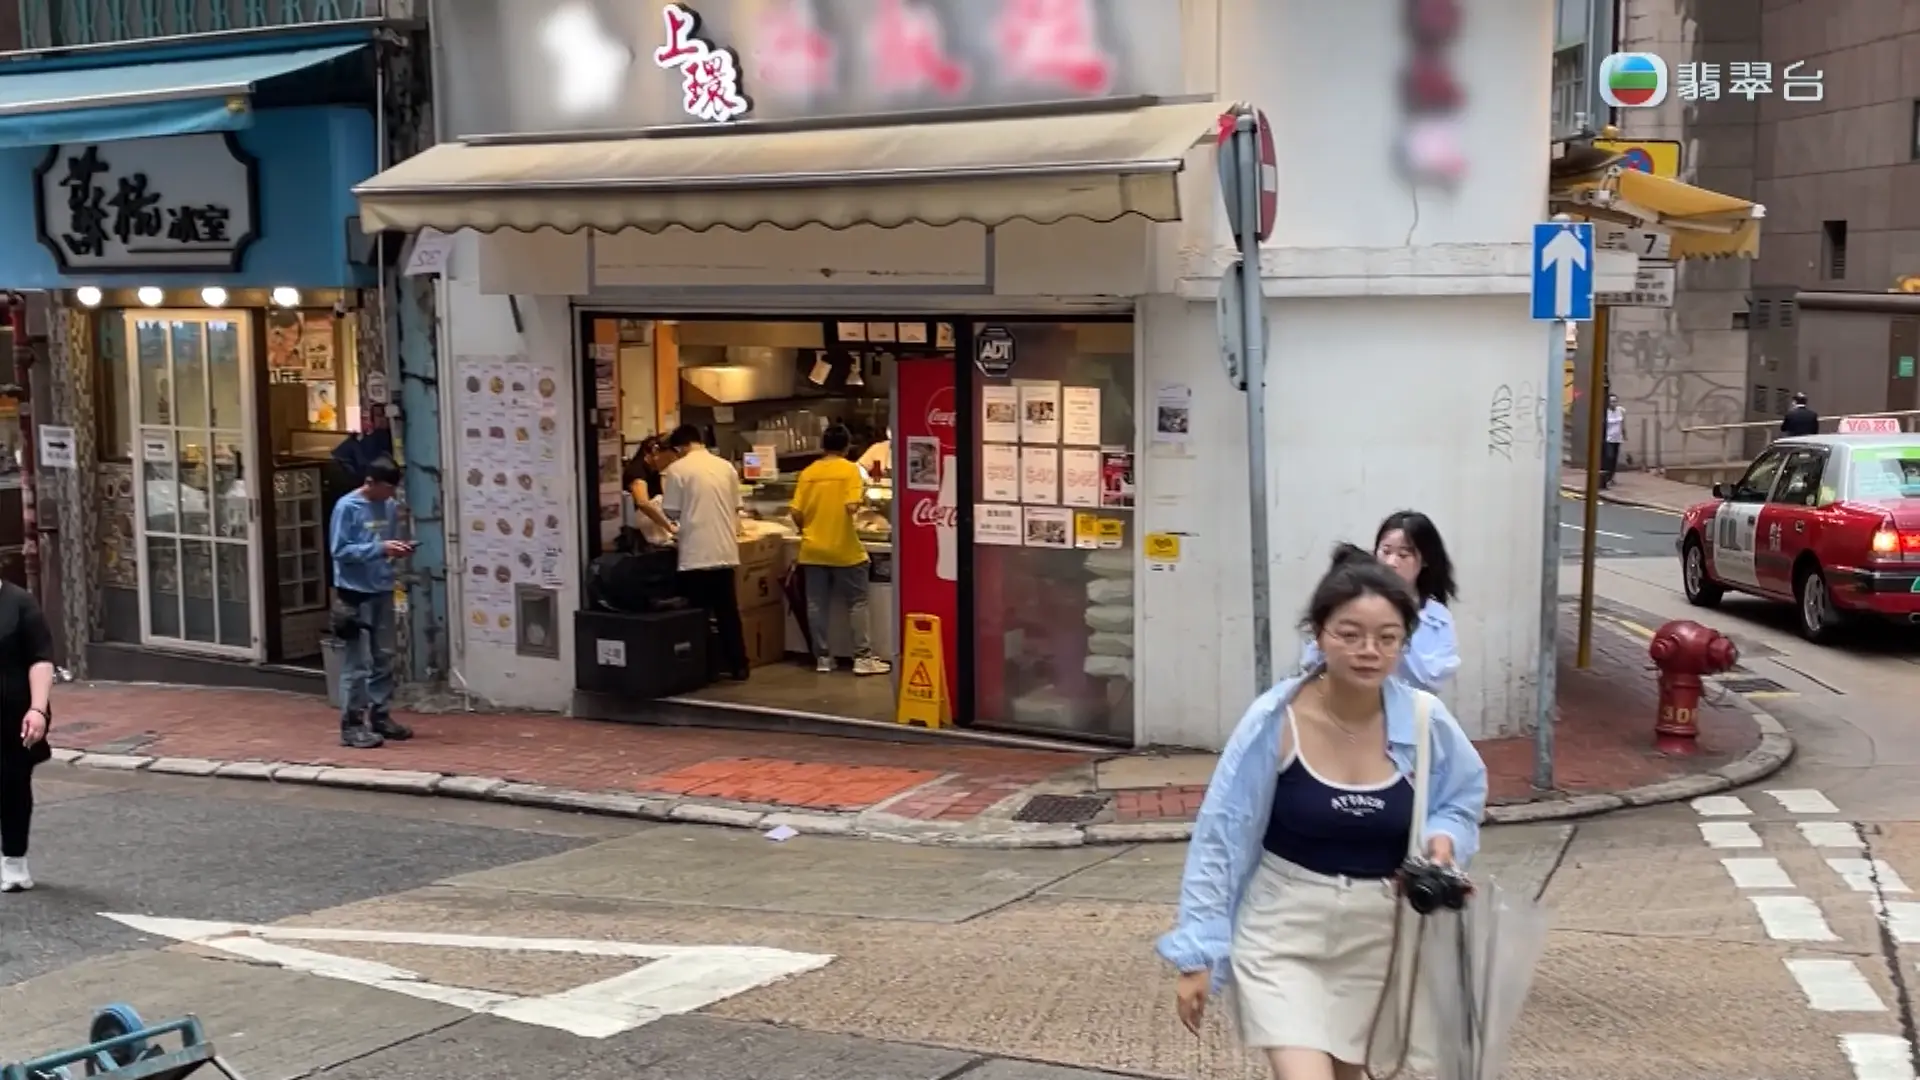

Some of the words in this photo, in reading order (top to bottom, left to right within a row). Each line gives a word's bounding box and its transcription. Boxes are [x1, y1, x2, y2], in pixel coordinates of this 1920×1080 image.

[657, 8, 742, 116] 上環
[1643, 234, 1657, 254] 7
[979, 339, 1013, 360] ADT
[1847, 420, 1896, 432] TAXI
